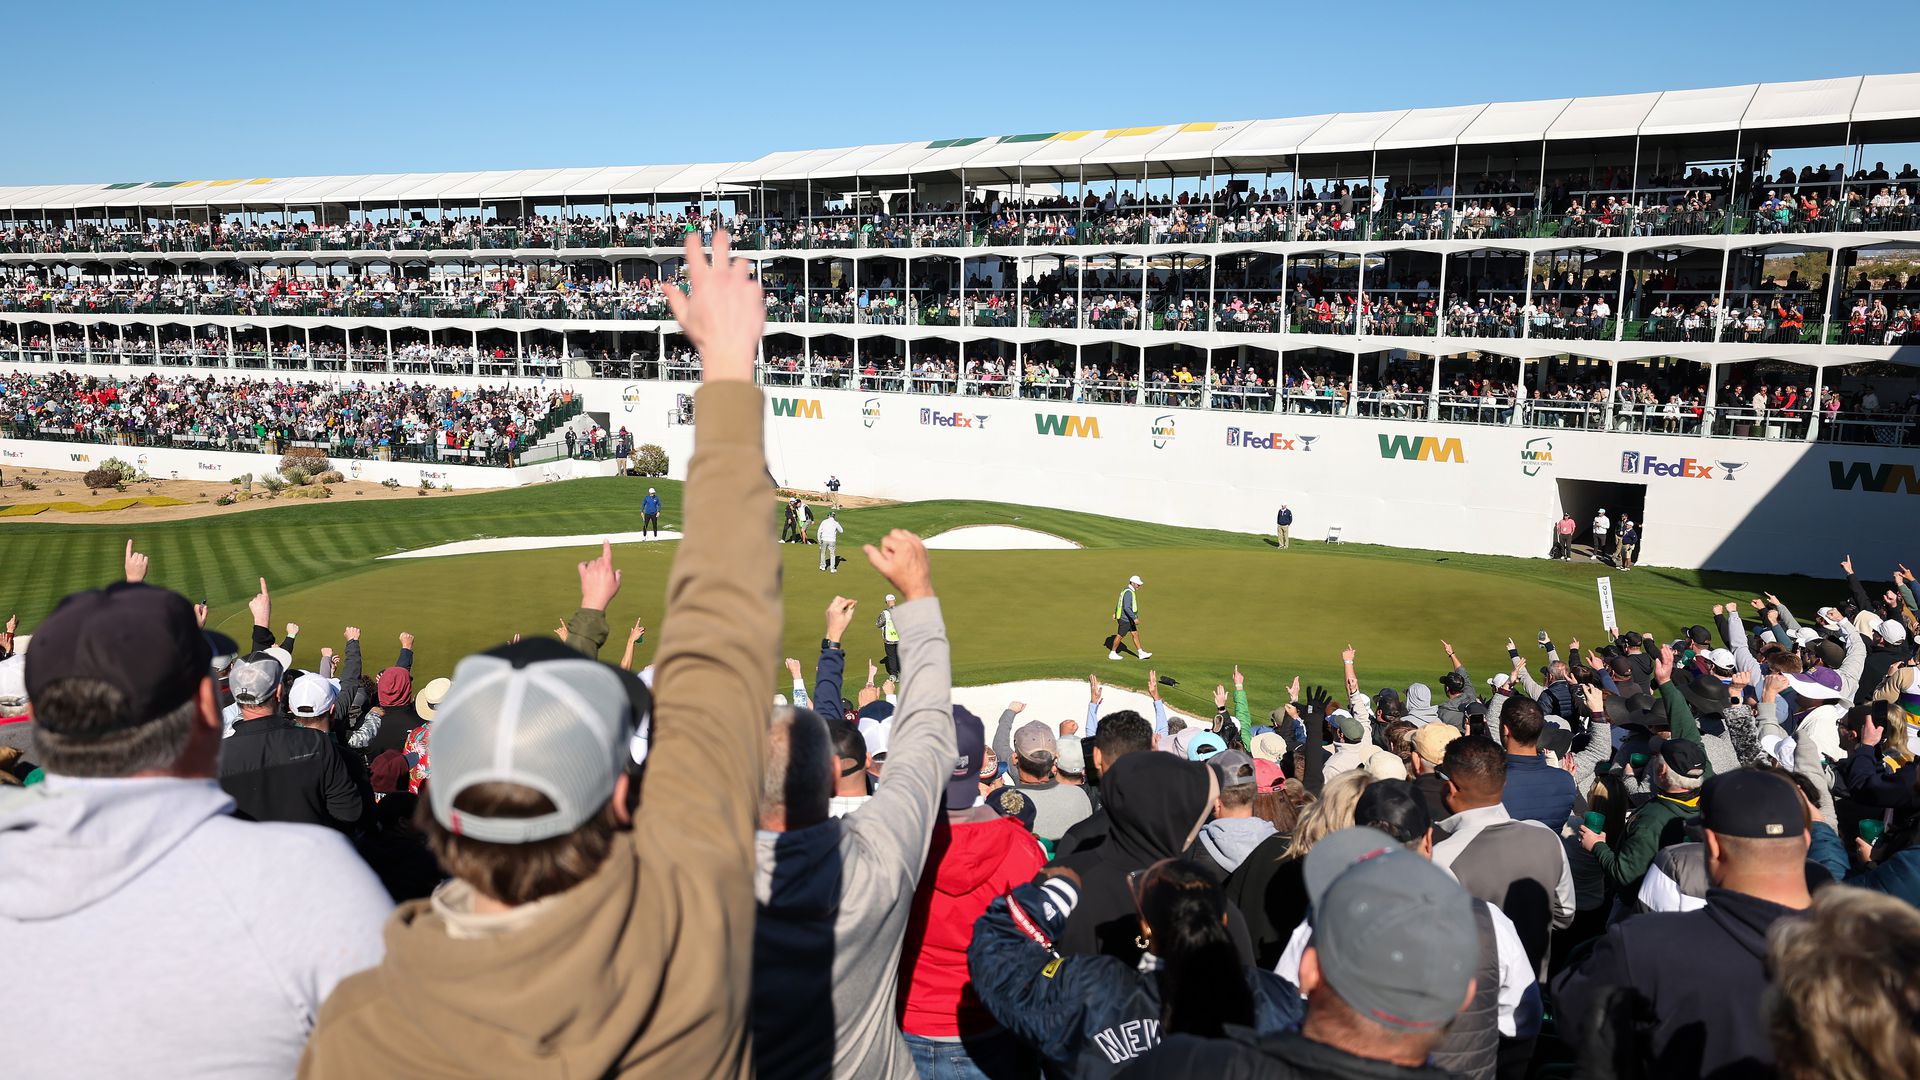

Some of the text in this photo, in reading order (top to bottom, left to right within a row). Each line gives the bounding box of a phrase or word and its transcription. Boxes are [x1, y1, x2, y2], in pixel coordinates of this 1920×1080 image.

[772, 397, 822, 419] WM
[862, 408, 880, 416] WM
[933, 411, 972, 428] FedEx
[1035, 413, 1100, 438] WM
[1151, 427, 1175, 436] WM
[1243, 431, 1295, 450] FedEx
[71, 454, 90, 462] WM
[1378, 434, 1464, 463] WM
[1521, 451, 1552, 461] WM
[1643, 455, 1713, 479] FedEx
[1829, 461, 1920, 495] WM
